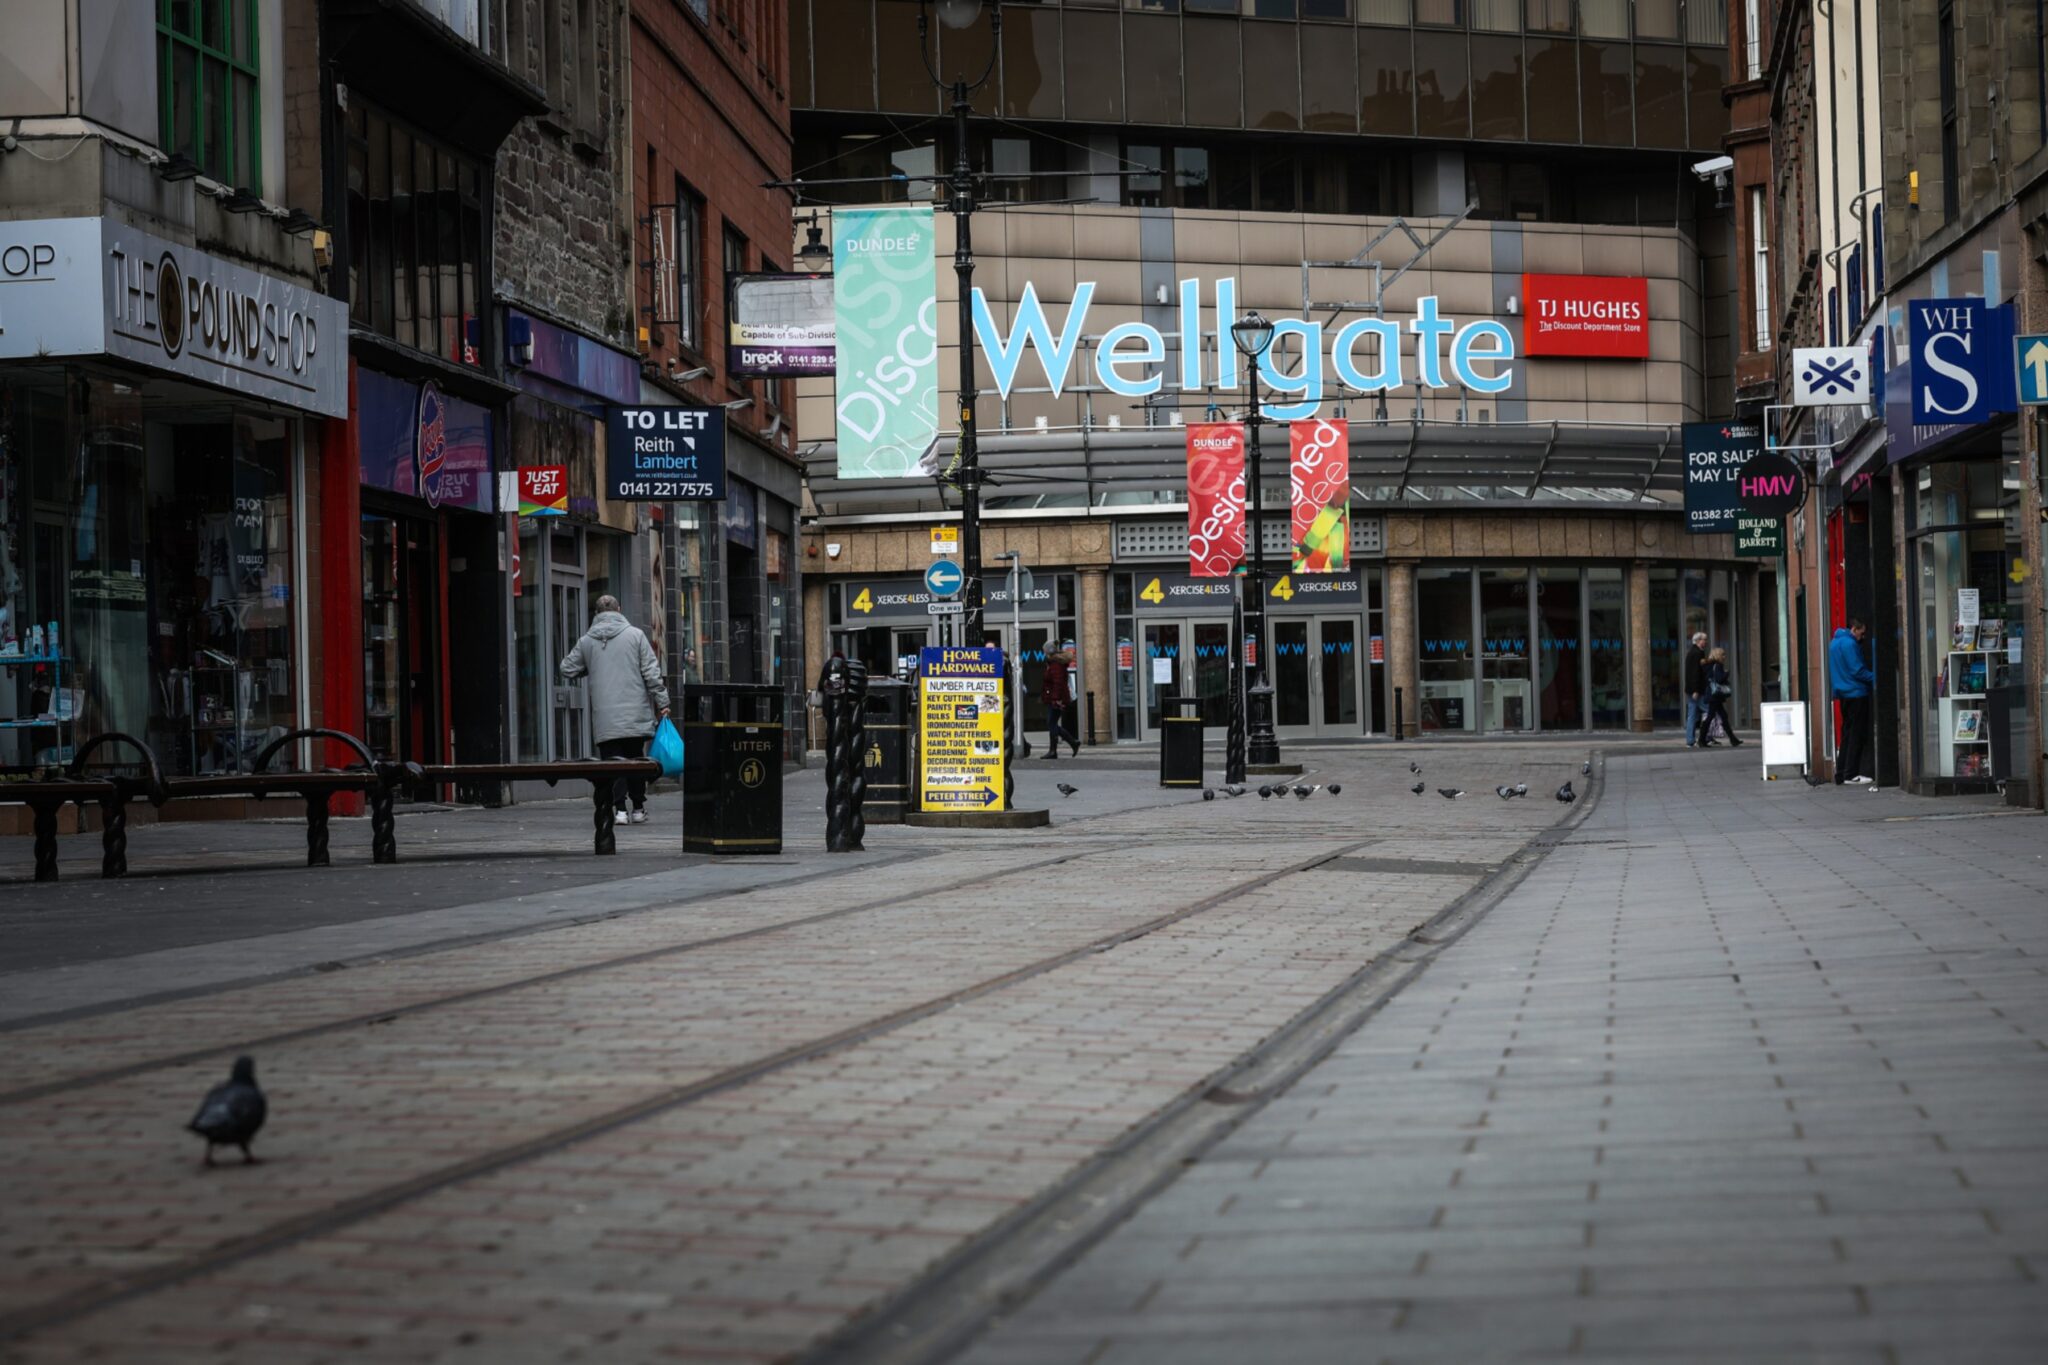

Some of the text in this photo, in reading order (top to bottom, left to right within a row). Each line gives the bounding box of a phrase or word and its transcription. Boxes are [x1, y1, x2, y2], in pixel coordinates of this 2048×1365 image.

[847, 239, 916, 252] DUNDEE
[2, 244, 55, 276] OP
[111, 250, 157, 330] THE
[1538, 299, 1641, 319] TJ HUGHES
[1920, 307, 1973, 330] WH
[1539, 321, 1641, 332] The Discount Department Store
[741, 331, 775, 341] Capable
[777, 331, 787, 339] of
[971, 277, 1514, 420] Wellgate
[742, 349, 783, 364] breck
[788, 355, 808, 363] 0141
[811, 355, 827, 363] 229
[1924, 331, 1978, 415] S
[622, 411, 709, 430] TO LET
[634, 436, 675, 452] Reith
[1193, 438, 1233, 447] DUNDEE
[635, 453, 698, 469] Lambert
[1689, 452, 1717, 466] FOR
[525, 470, 560, 485] JUST
[1690, 468, 1721, 483] MAY
[533, 483, 560, 495] EAT
[620, 482, 650, 495] 0141
[1741, 475, 1795, 497] HMV
[1691, 510, 1721, 520] 01382
[1738, 519, 1776, 529] HOLLAND
[1753, 528, 1762, 537] &
[1739, 537, 1776, 549] BARRETT
[1169, 585, 1231, 595] XERCISE4LESS
[1298, 581, 1358, 592] XERCISE4LESS
[877, 594, 930, 604] XERCISE4LESS
[947, 605, 961, 613] way
[943, 650, 981, 662] HOME
[928, 663, 995, 675] HARDWARE
[930, 681, 995, 691] NUMBER PLATES
[733, 741, 771, 751] LITTER
[928, 792, 989, 800] PETER STREET
